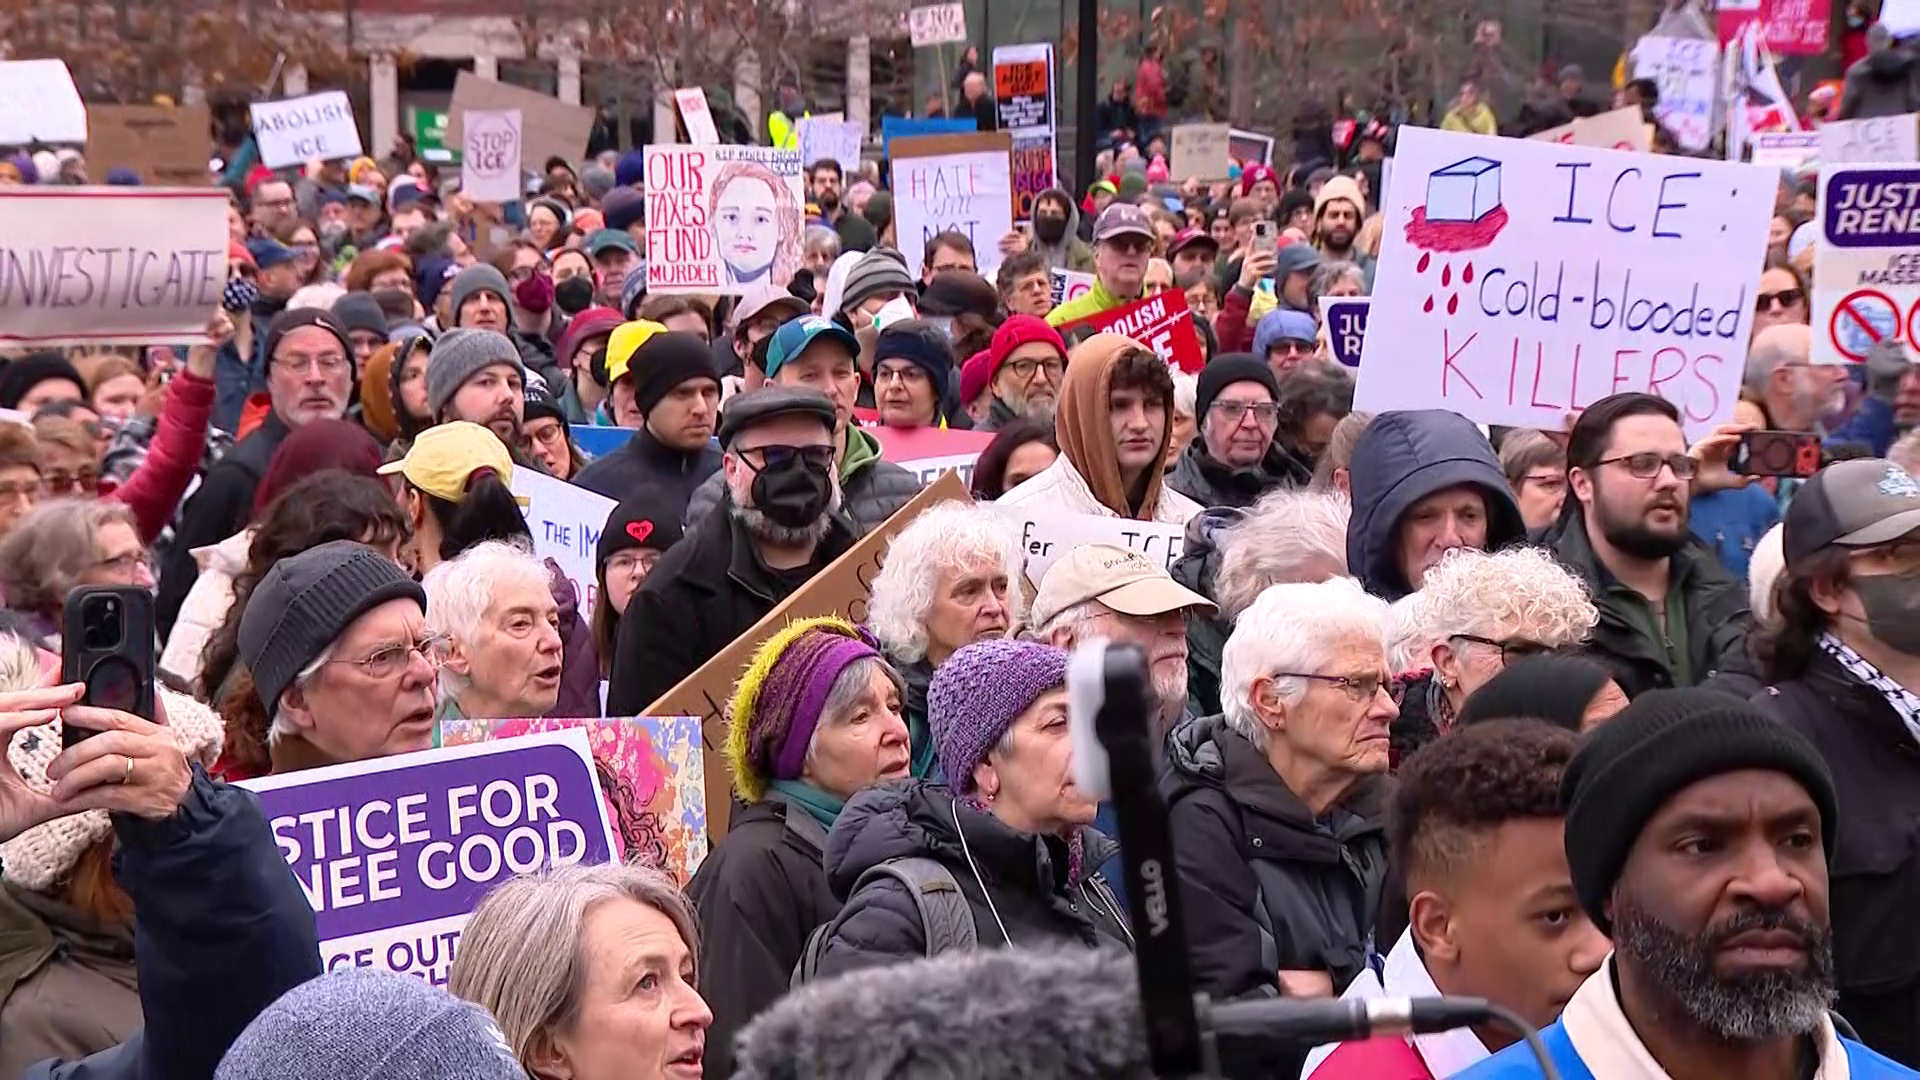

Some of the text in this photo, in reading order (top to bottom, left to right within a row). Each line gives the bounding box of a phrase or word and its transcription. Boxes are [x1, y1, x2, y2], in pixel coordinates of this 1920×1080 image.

[257, 102, 353, 134] ABOLISH
[292, 135, 329, 158] ICE
[470, 130, 513, 152] STOP
[475, 151, 505, 170] ICE
[649, 152, 705, 191] OUR
[911, 164, 985, 199] HATE
[647, 191, 706, 229] TAXES
[1834, 208, 1920, 236] RENE
[648, 228, 711, 263] FUND
[649, 263, 718, 284] MURDER
[1442, 328, 1724, 423] KILLERS
[542, 520, 571, 548] THE
[270, 774, 561, 865] STICE FOR
[292, 820, 587, 913] NEE GOOD
[1140, 859, 1169, 936] VELO
[386, 931, 461, 972] OUT
